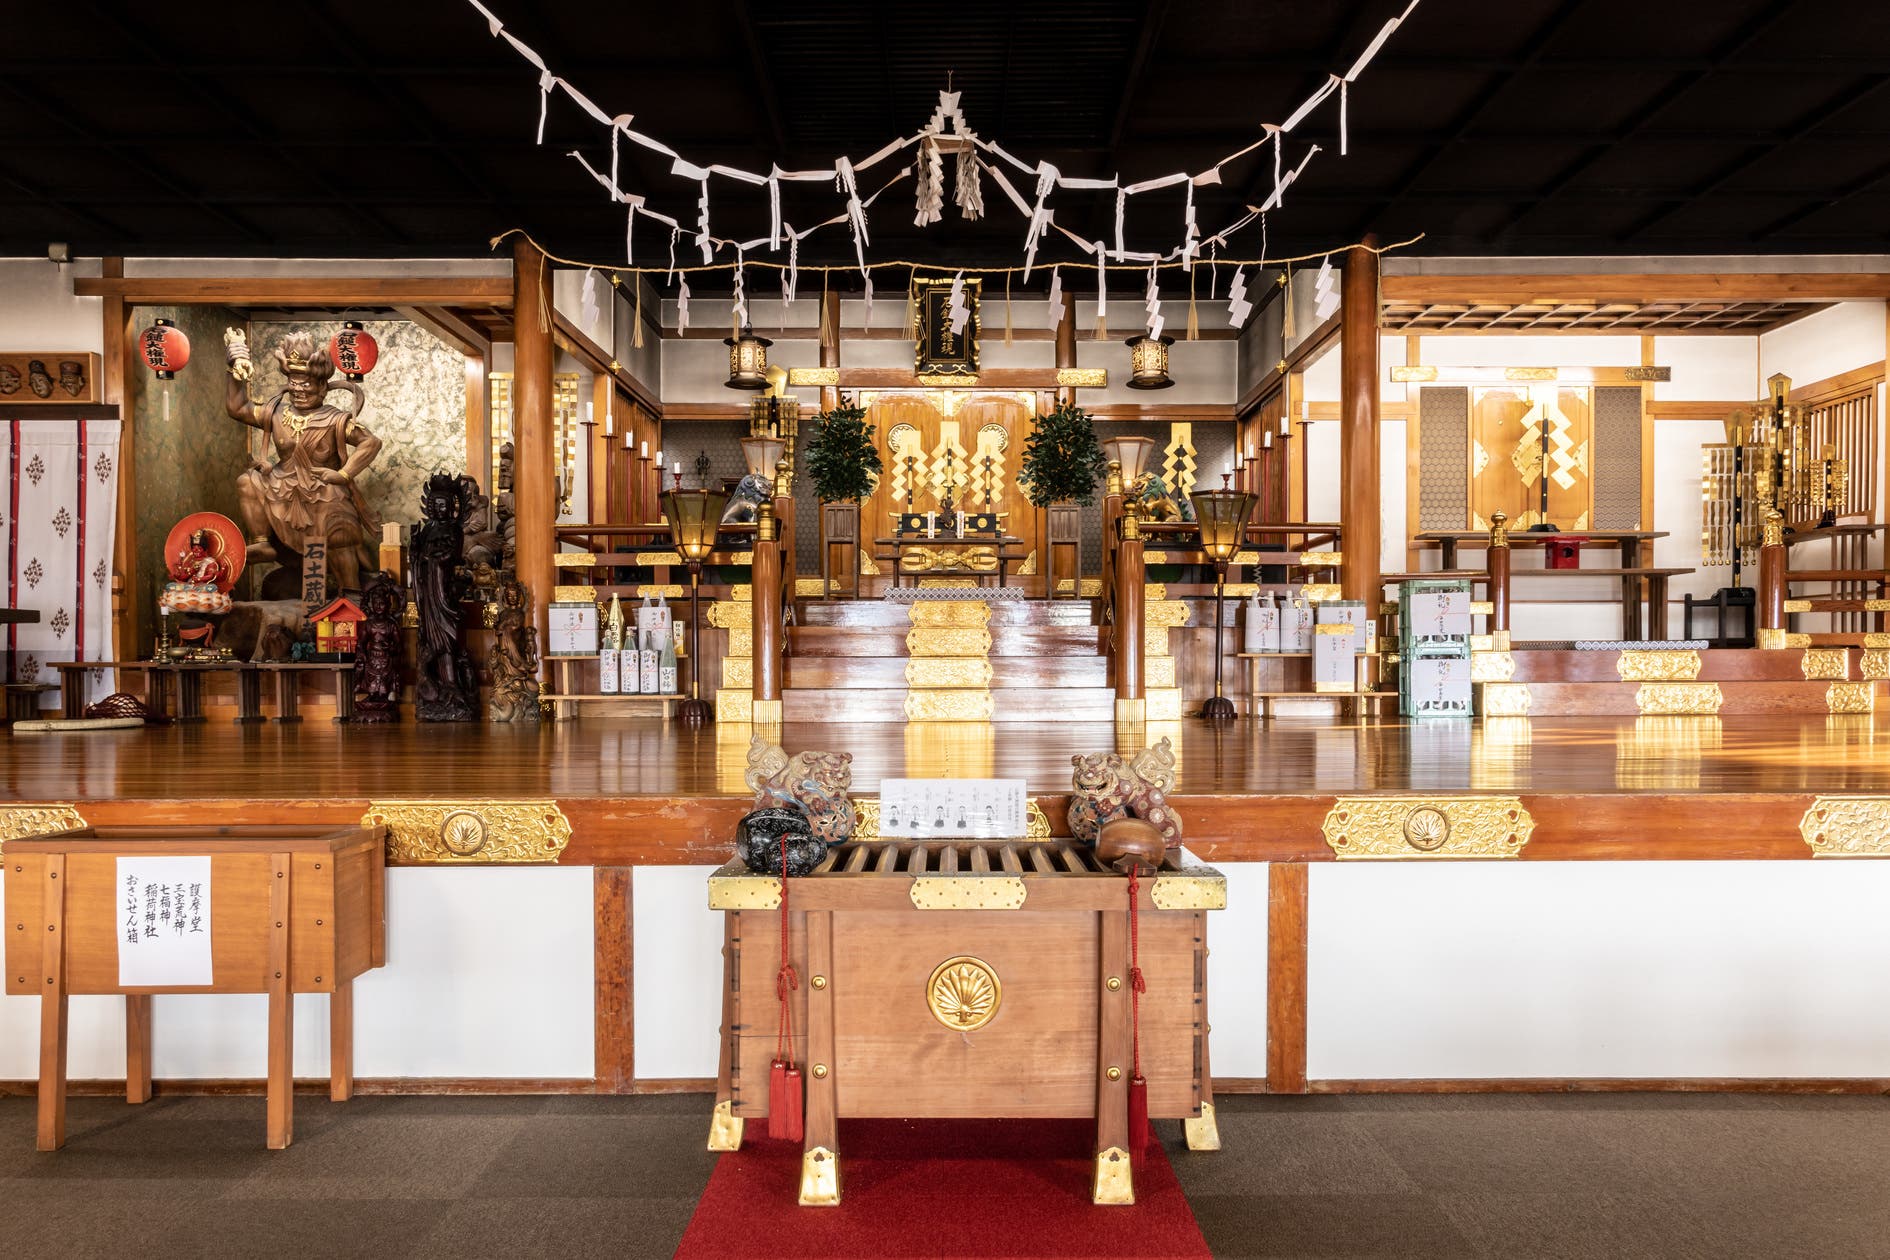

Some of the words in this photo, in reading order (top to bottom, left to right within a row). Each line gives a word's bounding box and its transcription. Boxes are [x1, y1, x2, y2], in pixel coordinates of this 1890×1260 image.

[126, 874, 139, 944] おさいせん箱
[144, 883, 159, 938] 稲荷神社
[188, 882, 204, 933] 護摩堂
